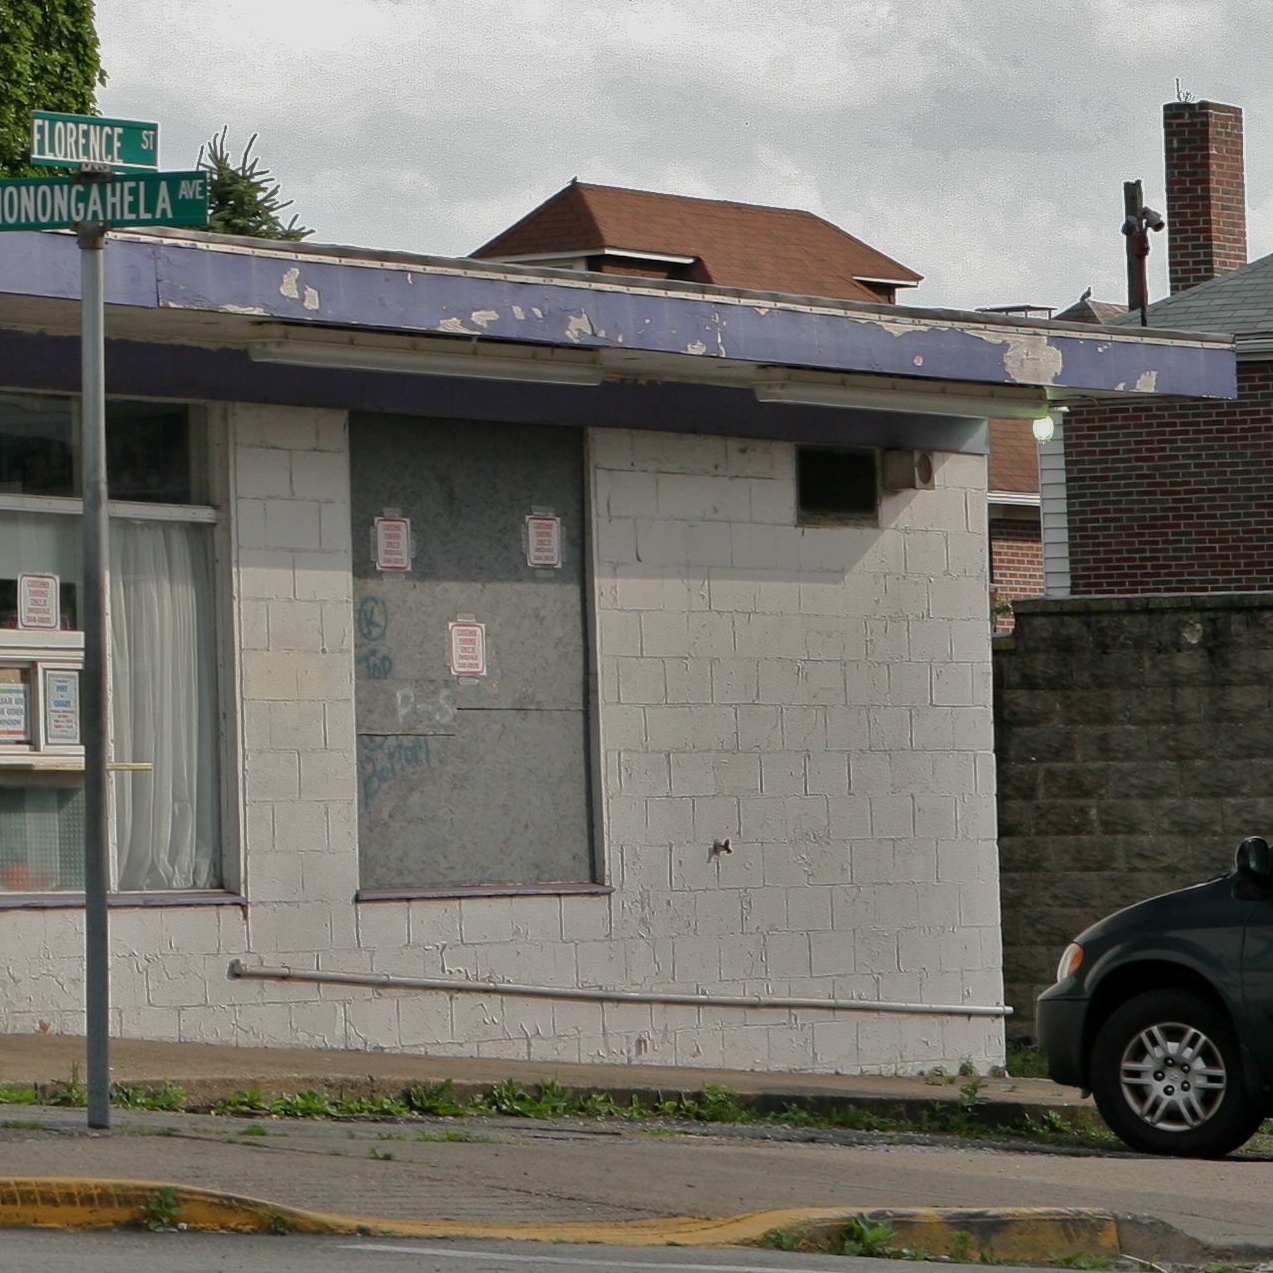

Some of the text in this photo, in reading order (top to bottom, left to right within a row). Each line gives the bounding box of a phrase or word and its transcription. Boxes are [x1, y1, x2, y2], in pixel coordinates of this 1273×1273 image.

[32, 118, 155, 164] FLORENCE ST
[179, 179, 204, 200] AVE
